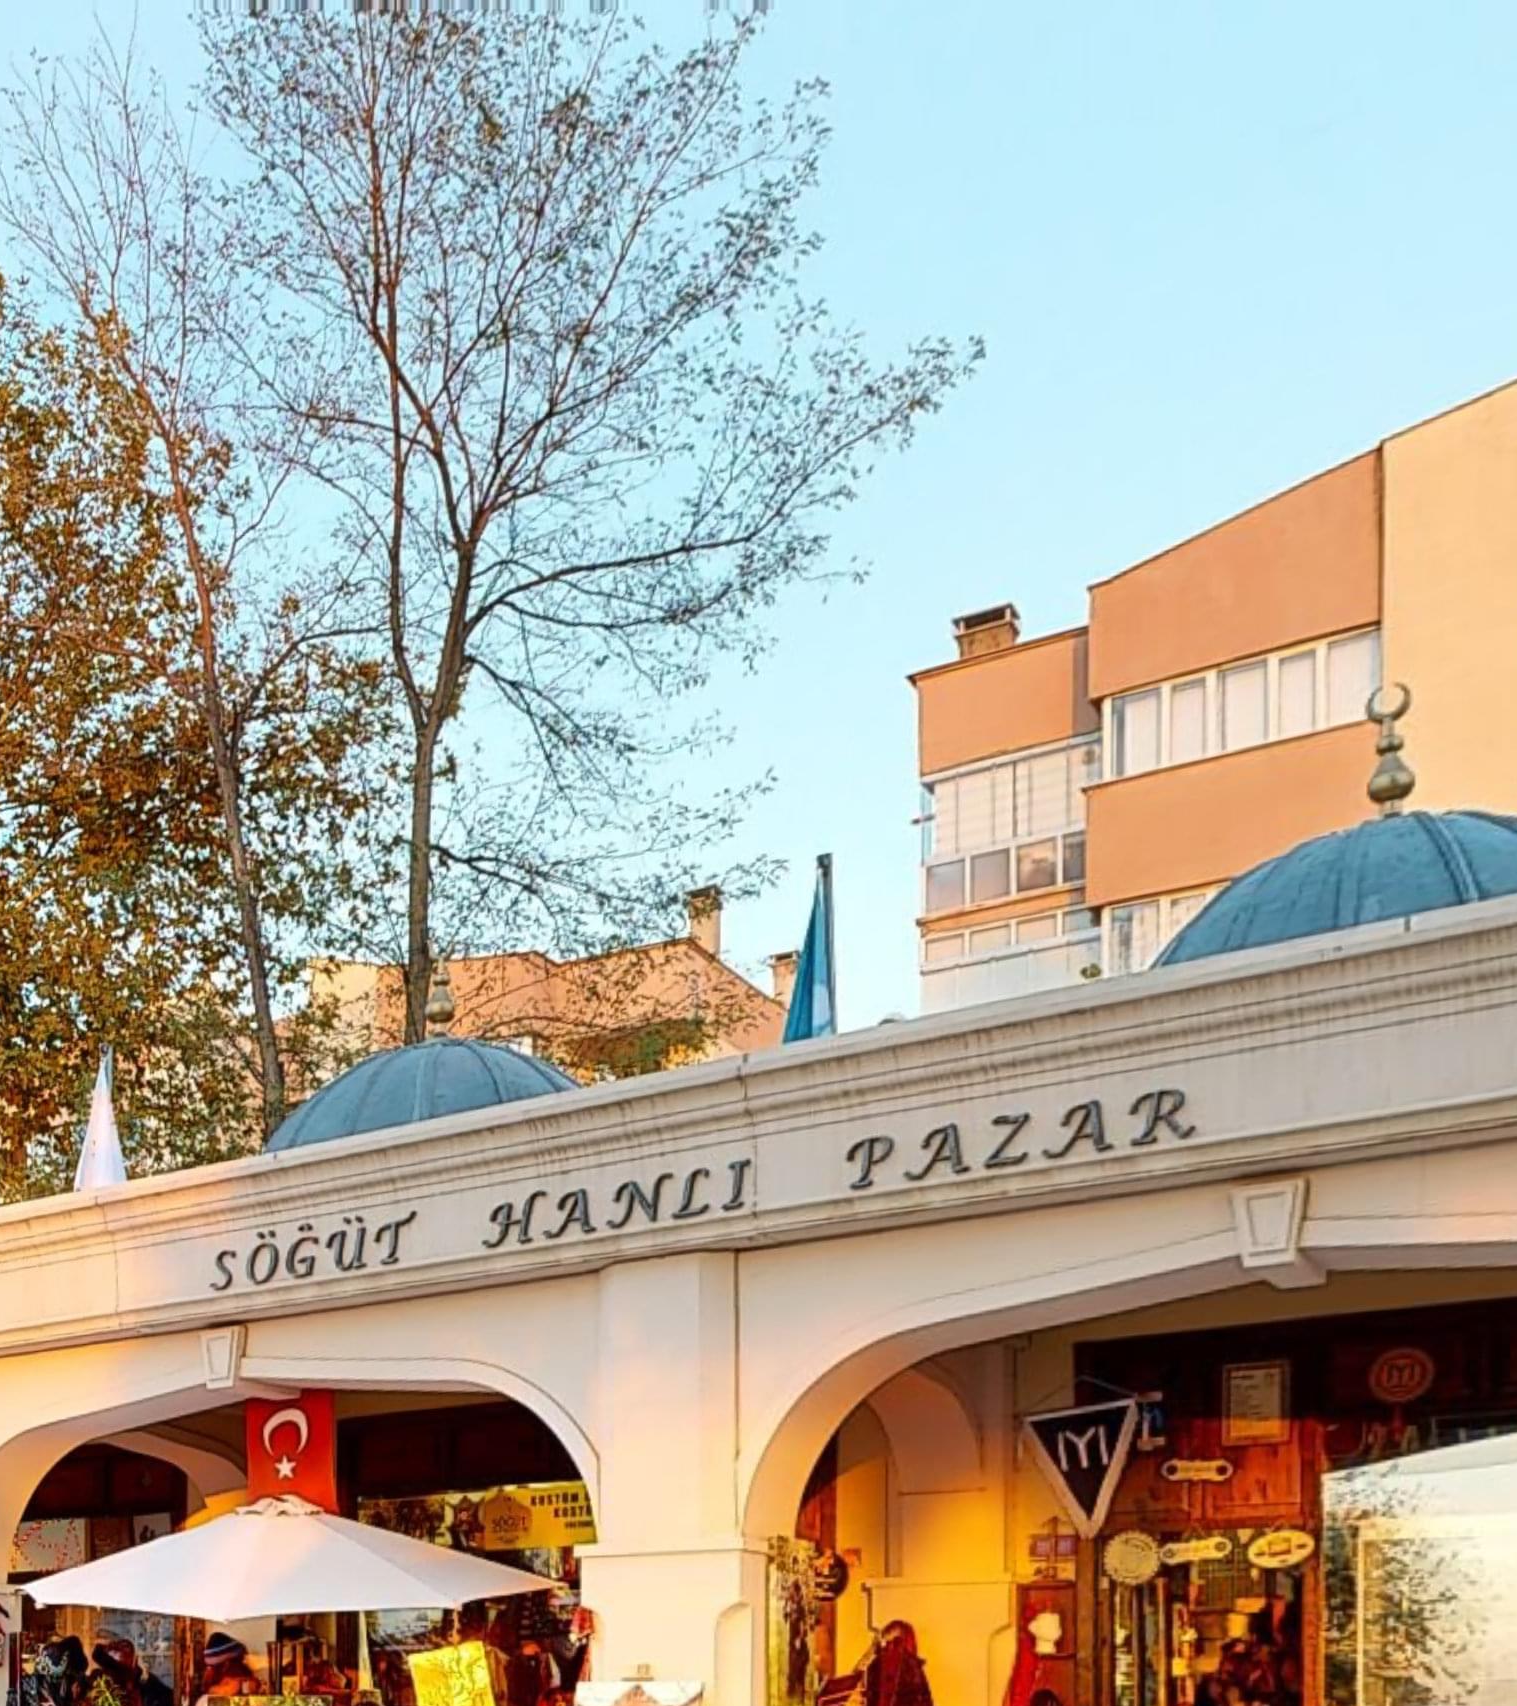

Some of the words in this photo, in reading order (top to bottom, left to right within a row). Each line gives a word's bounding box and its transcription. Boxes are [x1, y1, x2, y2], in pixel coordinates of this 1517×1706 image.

[209, 1210, 418, 1292] SÖĞÜT
[481, 1158, 752, 1249] HANLI
[845, 1088, 1197, 1191] PAZAR
